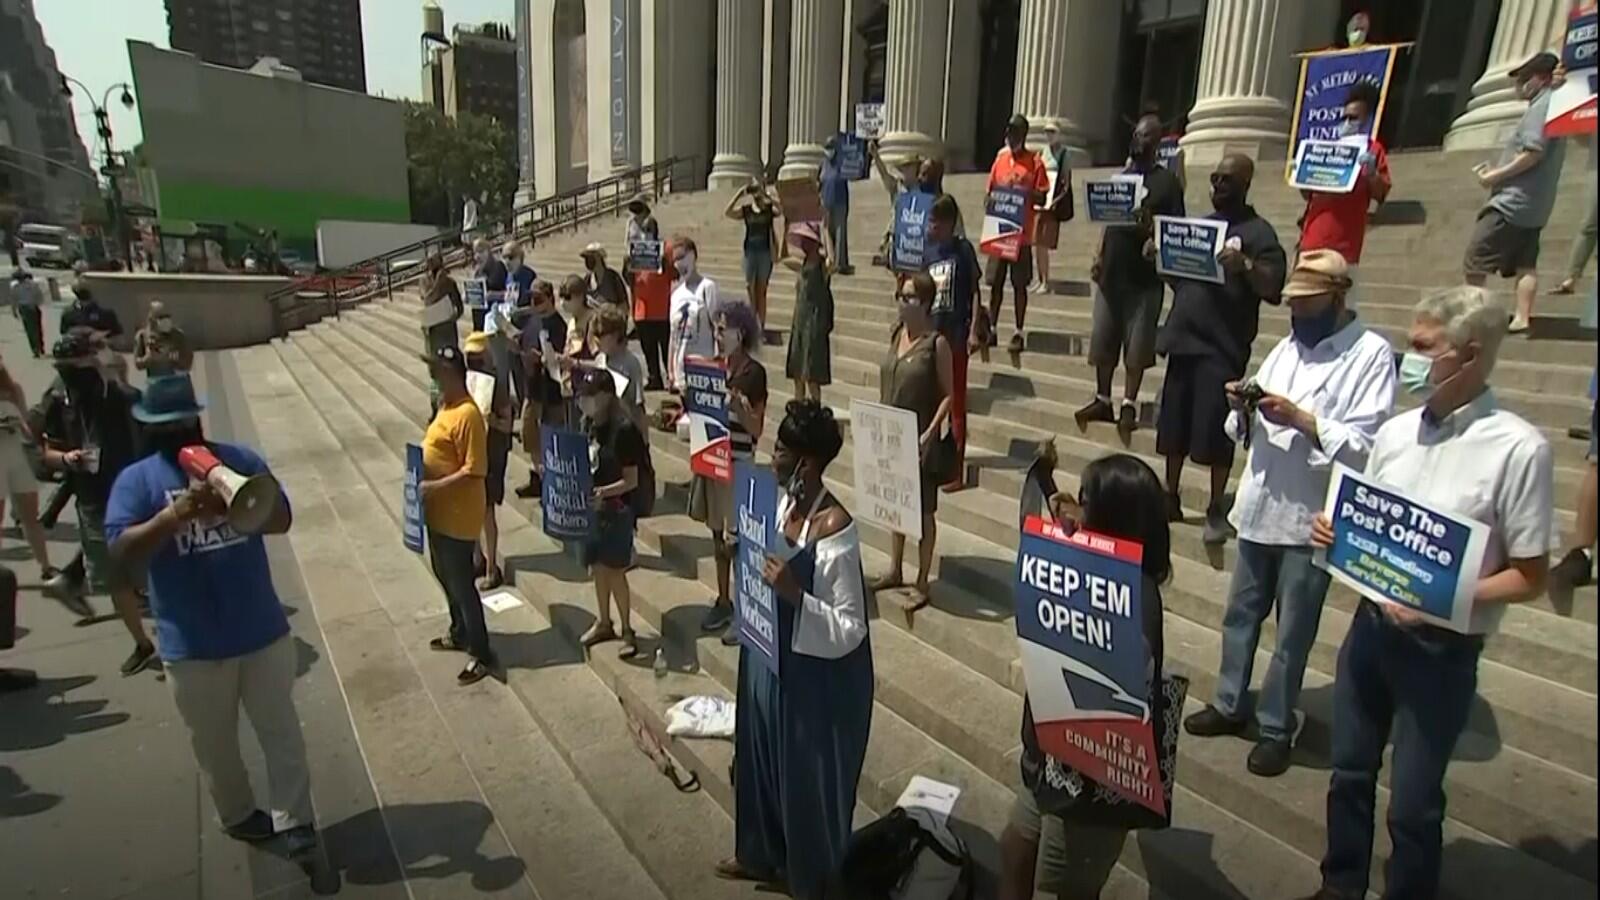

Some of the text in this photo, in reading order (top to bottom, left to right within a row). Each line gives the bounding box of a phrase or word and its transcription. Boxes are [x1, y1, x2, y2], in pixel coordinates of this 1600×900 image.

[1308, 107, 1345, 122] POST
[1163, 233, 1212, 250] Post Office
[1167, 224, 1209, 239] Save The
[739, 503, 766, 549] Stand
[1341, 501, 1453, 567] Post Office
[1354, 485, 1446, 539] Save The
[741, 561, 774, 613] Postal
[1021, 553, 1131, 618] KEEP 'EM
[1344, 559, 1423, 607] Service Cuts
[1380, 547, 1434, 585] Funding
[739, 590, 774, 644] Workers
[1037, 598, 1113, 651] OPEN!
[1065, 728, 1152, 781] COMMUNITY
[1106, 730, 1147, 761] IT'S A
[1107, 766, 1154, 801] RIGHT!
